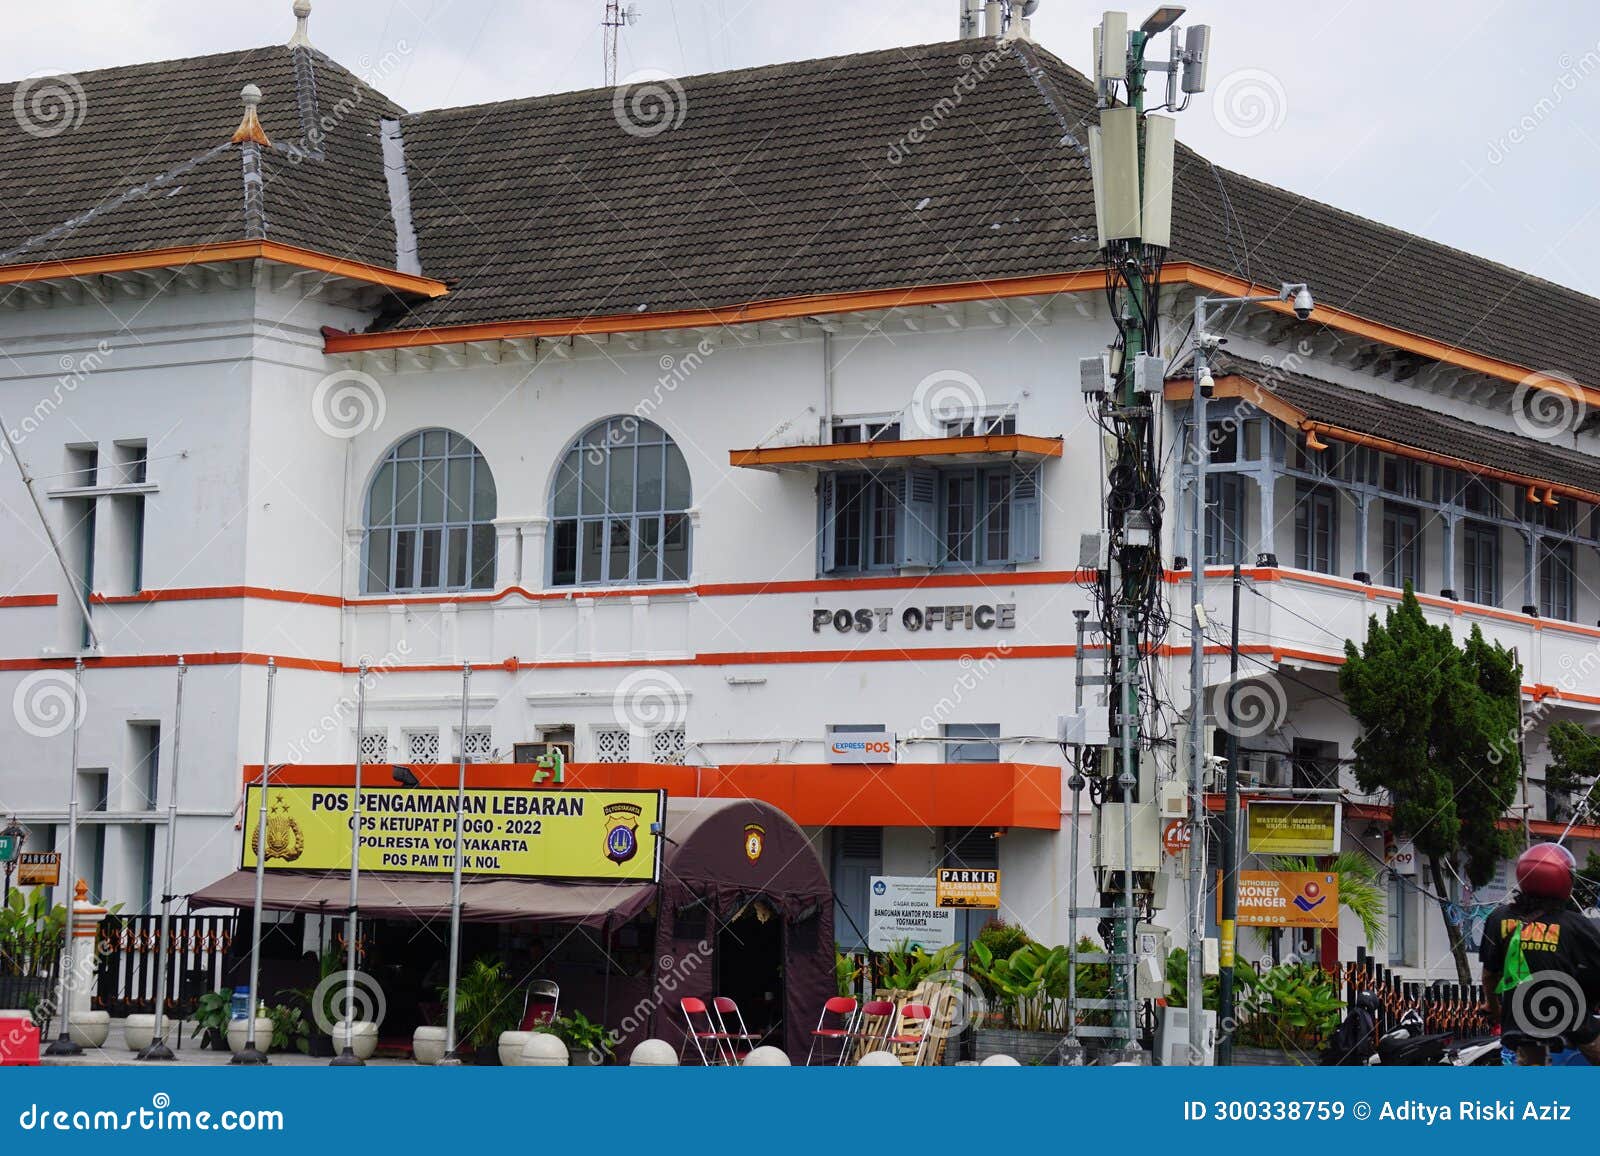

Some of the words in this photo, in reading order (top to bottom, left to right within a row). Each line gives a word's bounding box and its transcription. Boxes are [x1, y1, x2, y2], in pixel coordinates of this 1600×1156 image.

[812, 607, 893, 634] POST
[902, 604, 1016, 632] OFFICE
[835, 742, 865, 750] EXPRESS
[865, 742, 890, 753] POS
[312, 793, 349, 811] POS
[492, 797, 584, 816] LEBARAN
[380, 817, 440, 832] KETUPAT
[443, 819, 494, 833] POGO
[505, 820, 541, 834] 2022
[358, 836, 429, 850] POLRESTA
[22, 854, 56, 863] PARKIR
[383, 853, 407, 866] POS
[411, 854, 438, 867] PAM
[443, 855, 471, 868] TIK
[476, 856, 500, 868] NOL
[942, 871, 995, 882] PARKIR
[1238, 887, 1279, 897] MONEY
[1238, 898, 1286, 907] HANGER
[874, 909, 900, 917] BANGUNAN
[902, 909, 921, 918] KANTOR
[922, 910, 931, 918] POS
[933, 911, 948, 919] BESAR
[896, 918, 927, 926] YOGYAKARTA
